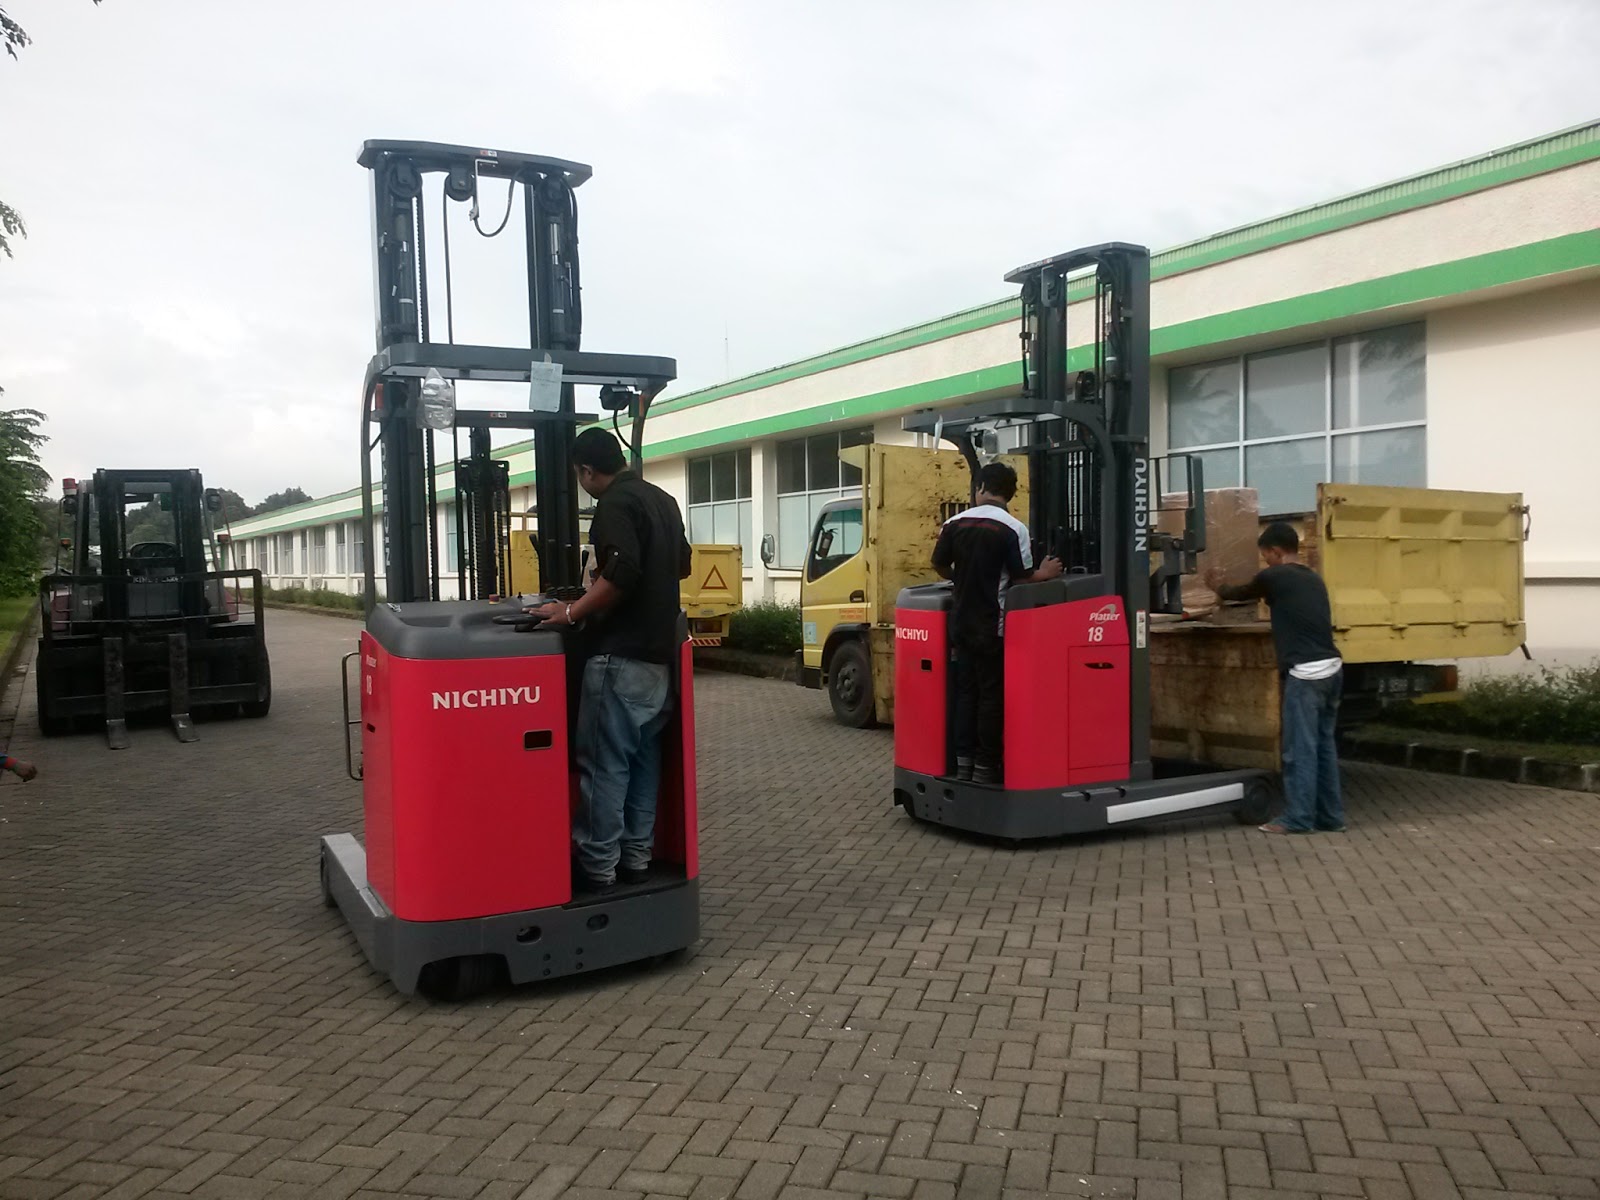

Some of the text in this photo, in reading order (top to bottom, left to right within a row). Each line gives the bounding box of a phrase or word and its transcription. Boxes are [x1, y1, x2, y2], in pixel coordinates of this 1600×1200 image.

[1135, 457, 1148, 552] NICHIYU
[895, 627, 929, 642] NICHIYU
[1088, 626, 1104, 642] 18
[431, 686, 540, 709] NICHIYU
